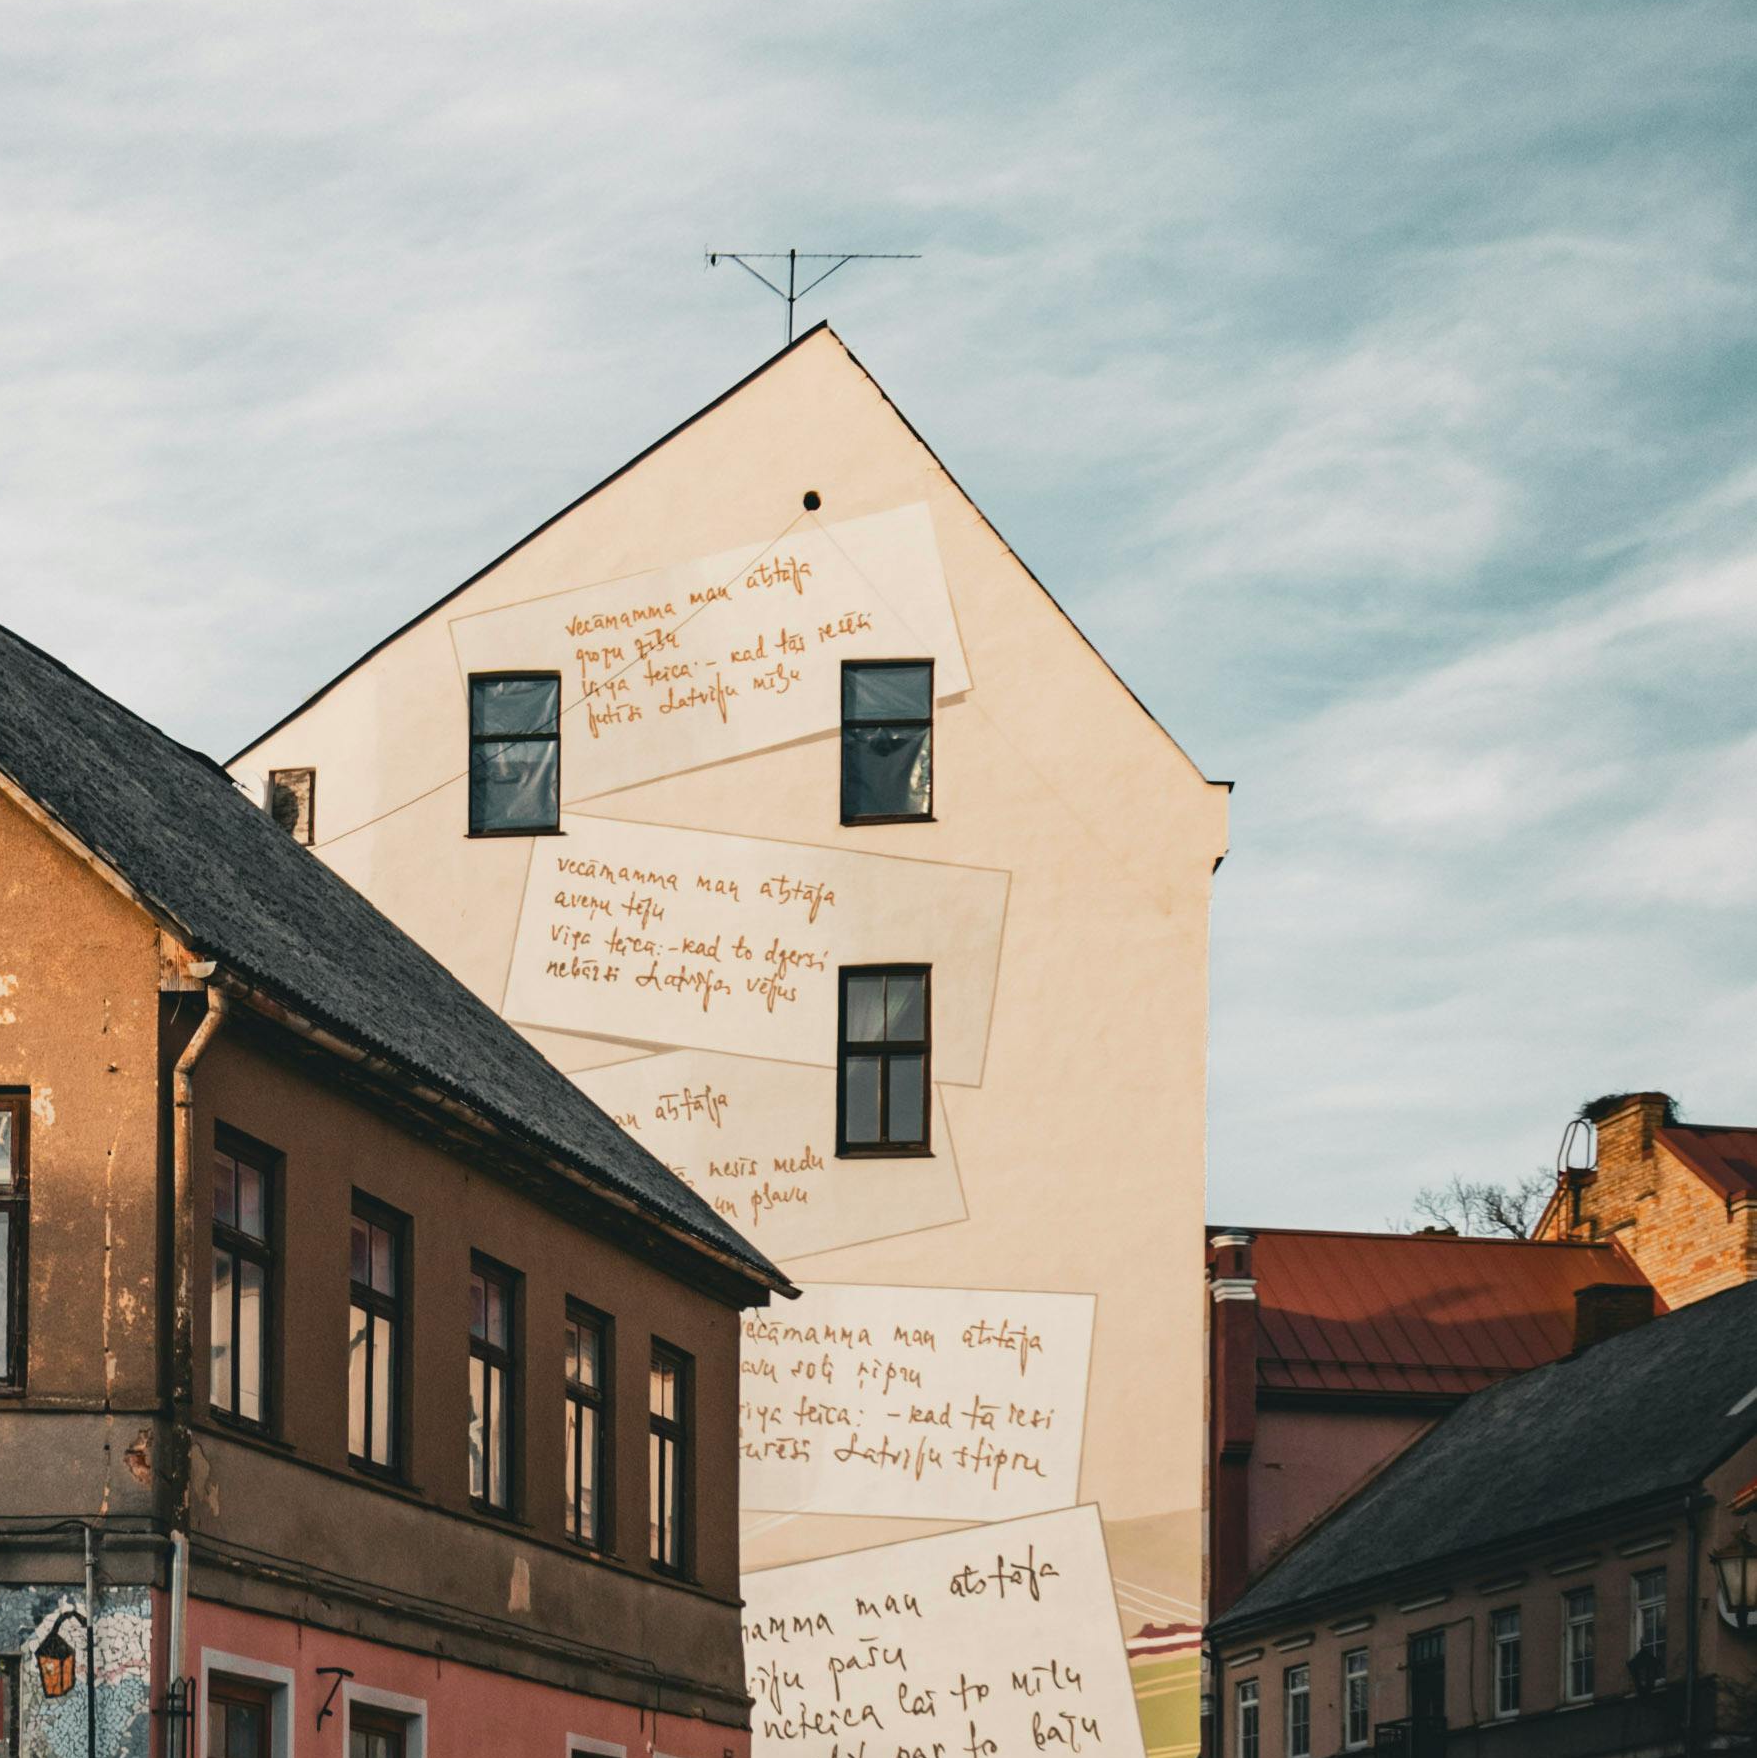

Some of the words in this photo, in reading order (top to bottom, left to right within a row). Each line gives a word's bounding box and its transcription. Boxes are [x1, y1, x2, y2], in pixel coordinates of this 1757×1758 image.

[696, 874, 740, 902] man
[731, 935, 753, 960] to
[742, 1319, 873, 1349] ecāmamma
[855, 1593, 923, 1619] man
[950, 1673, 990, 1712] to
